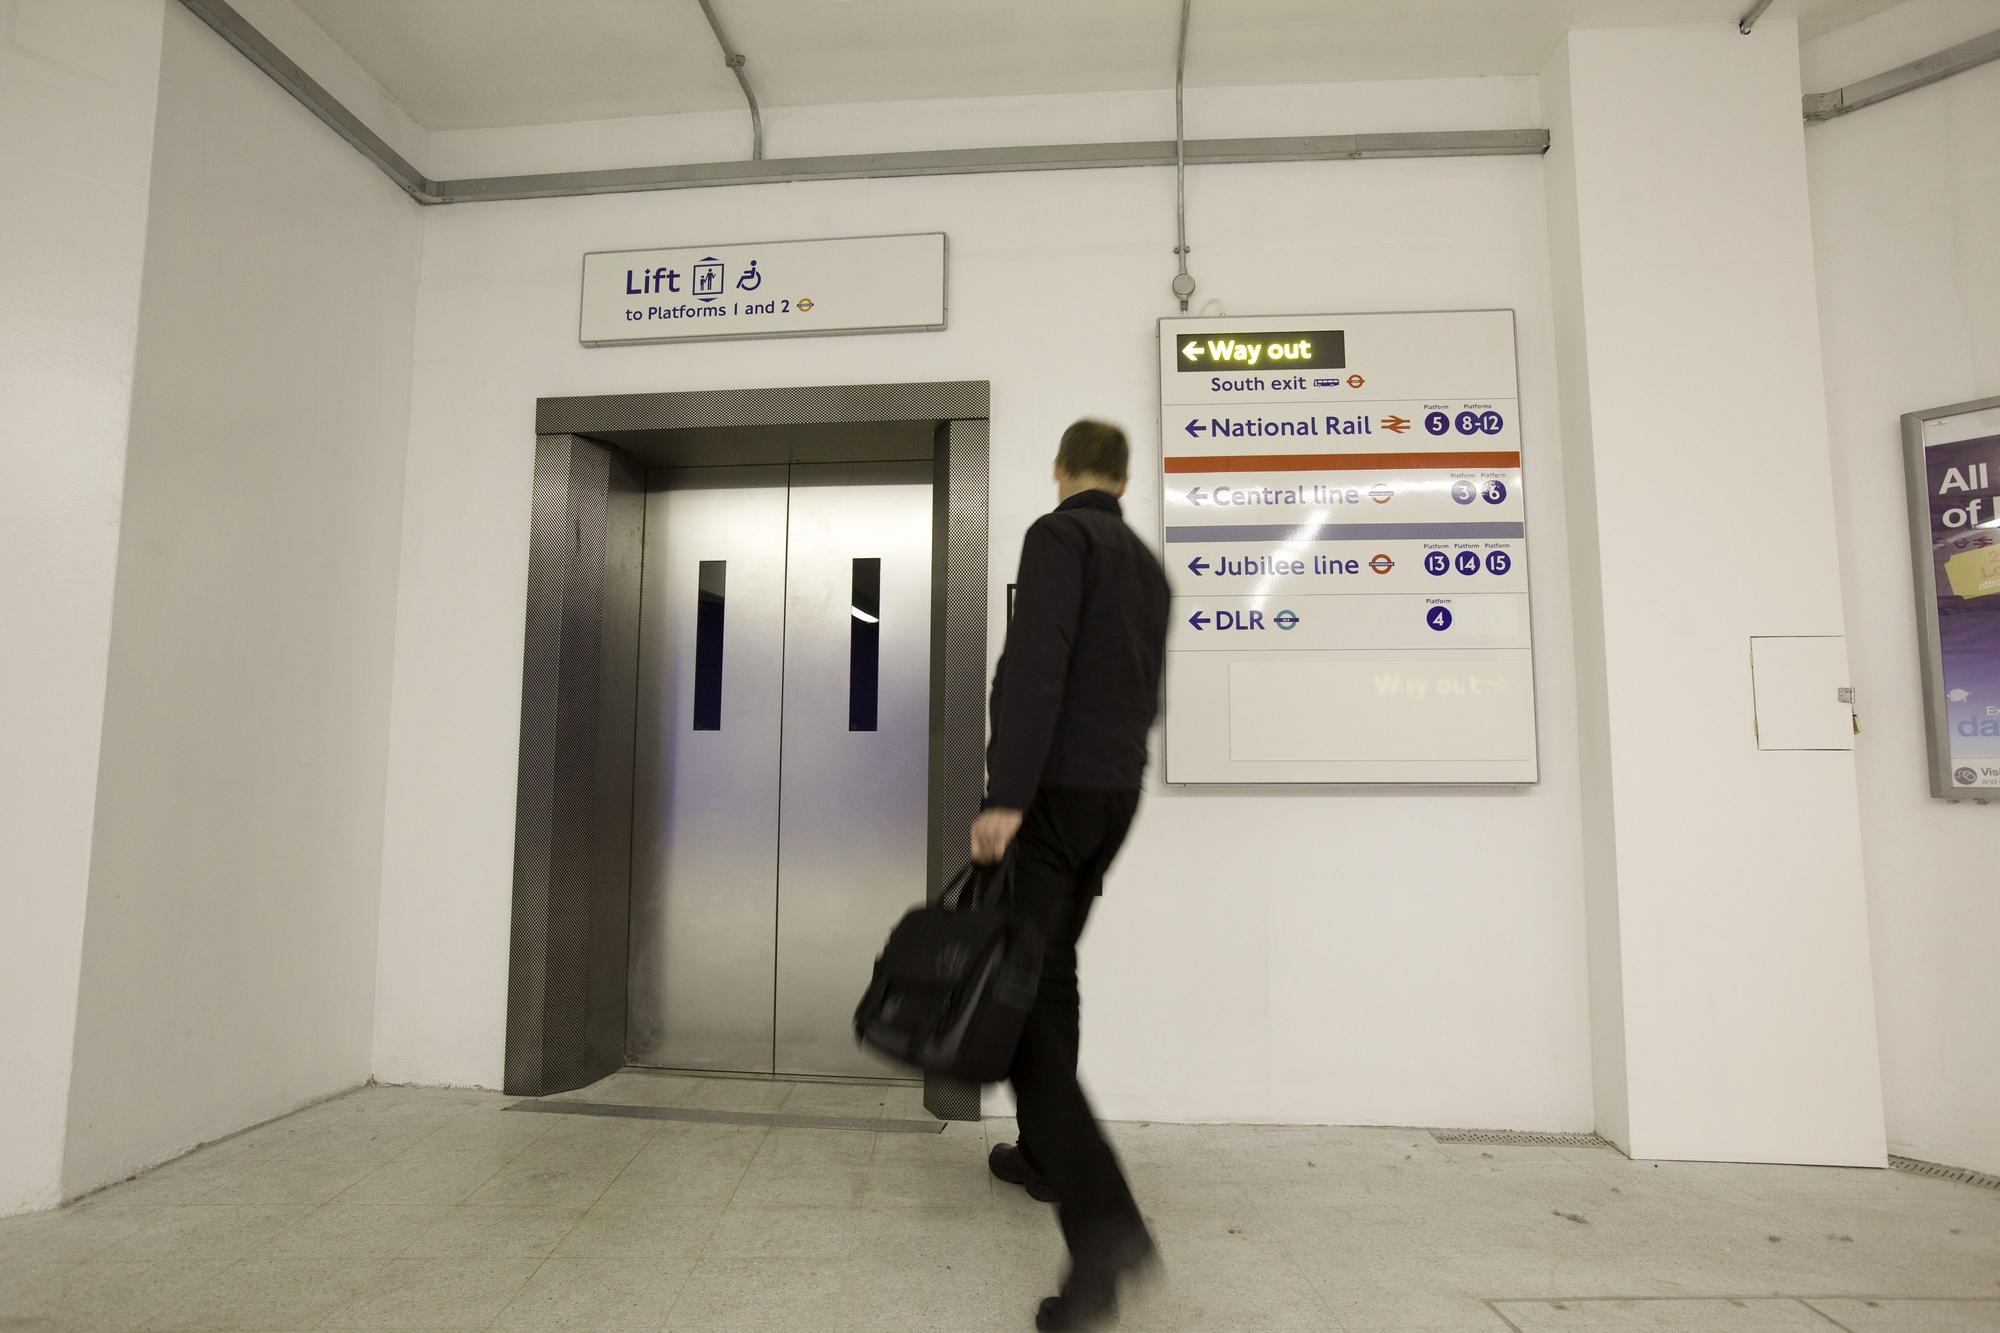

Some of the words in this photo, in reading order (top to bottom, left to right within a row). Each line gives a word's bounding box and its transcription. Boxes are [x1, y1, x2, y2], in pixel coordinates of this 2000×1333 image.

[626, 267, 681, 295] Lift
[625, 309, 643, 321] to
[648, 304, 727, 320] Platforms
[744, 300, 775, 316] and
[780, 299, 790, 313] 2
[1207, 339, 1262, 366] Way
[1267, 339, 1312, 360] out
[1211, 376, 1265, 392] South
[1271, 376, 1307, 390] exit
[1211, 416, 1319, 438] National
[1326, 415, 1372, 436] Rail
[1432, 416, 1443, 431] 5
[1462, 415, 1500, 431] 8-12
[1938, 462, 1989, 495] All
[1213, 485, 1306, 506] Central
[1313, 484, 1359, 505] line
[1458, 485, 1470, 500] 3
[1488, 484, 1500, 500] 6
[1942, 498, 1982, 528] of
[1214, 556, 1305, 577] Jubilee
[1314, 555, 1359, 575] line
[1428, 555, 1446, 571] 13
[1459, 555, 1476, 571] 14
[1490, 555, 1506, 571] 15
[1216, 610, 1266, 631] DLR
[1432, 611, 1445, 626] 4
[1434, 674, 1482, 695] out
